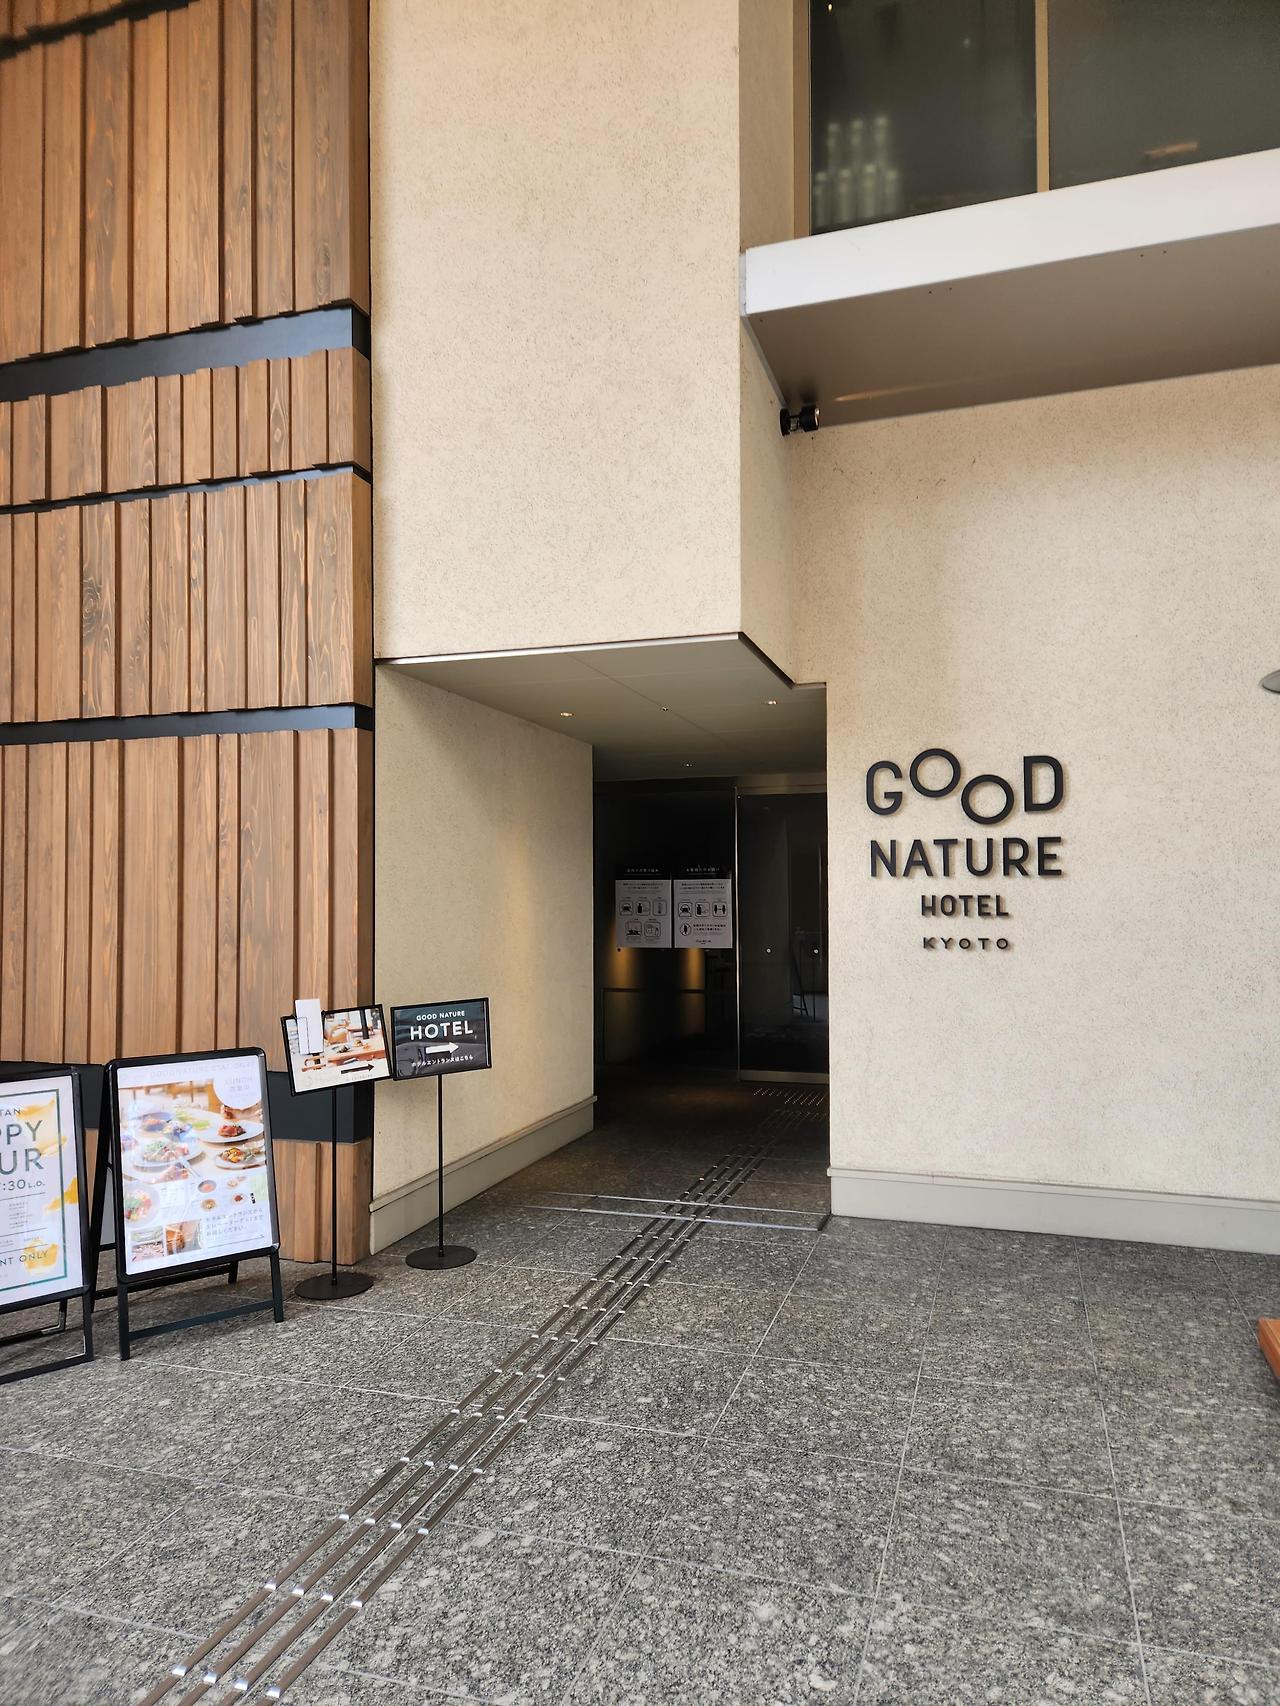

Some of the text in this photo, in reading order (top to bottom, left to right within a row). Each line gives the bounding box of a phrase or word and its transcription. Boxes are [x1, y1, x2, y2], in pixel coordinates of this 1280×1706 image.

[866, 748, 1064, 825] GOOD
[870, 836, 1063, 878] NATURE
[921, 894, 1009, 917] HOTEL
[923, 937, 1009, 950] KYOTO
[416, 1010, 465, 1021] GOOD NATURE
[410, 1020, 474, 1041] HOTEL
[411, 1054, 474, 1067] ホテルエントランスはこちら
[0, 1119, 43, 1145] PY
[19, 1250, 48, 1262] ONLY
